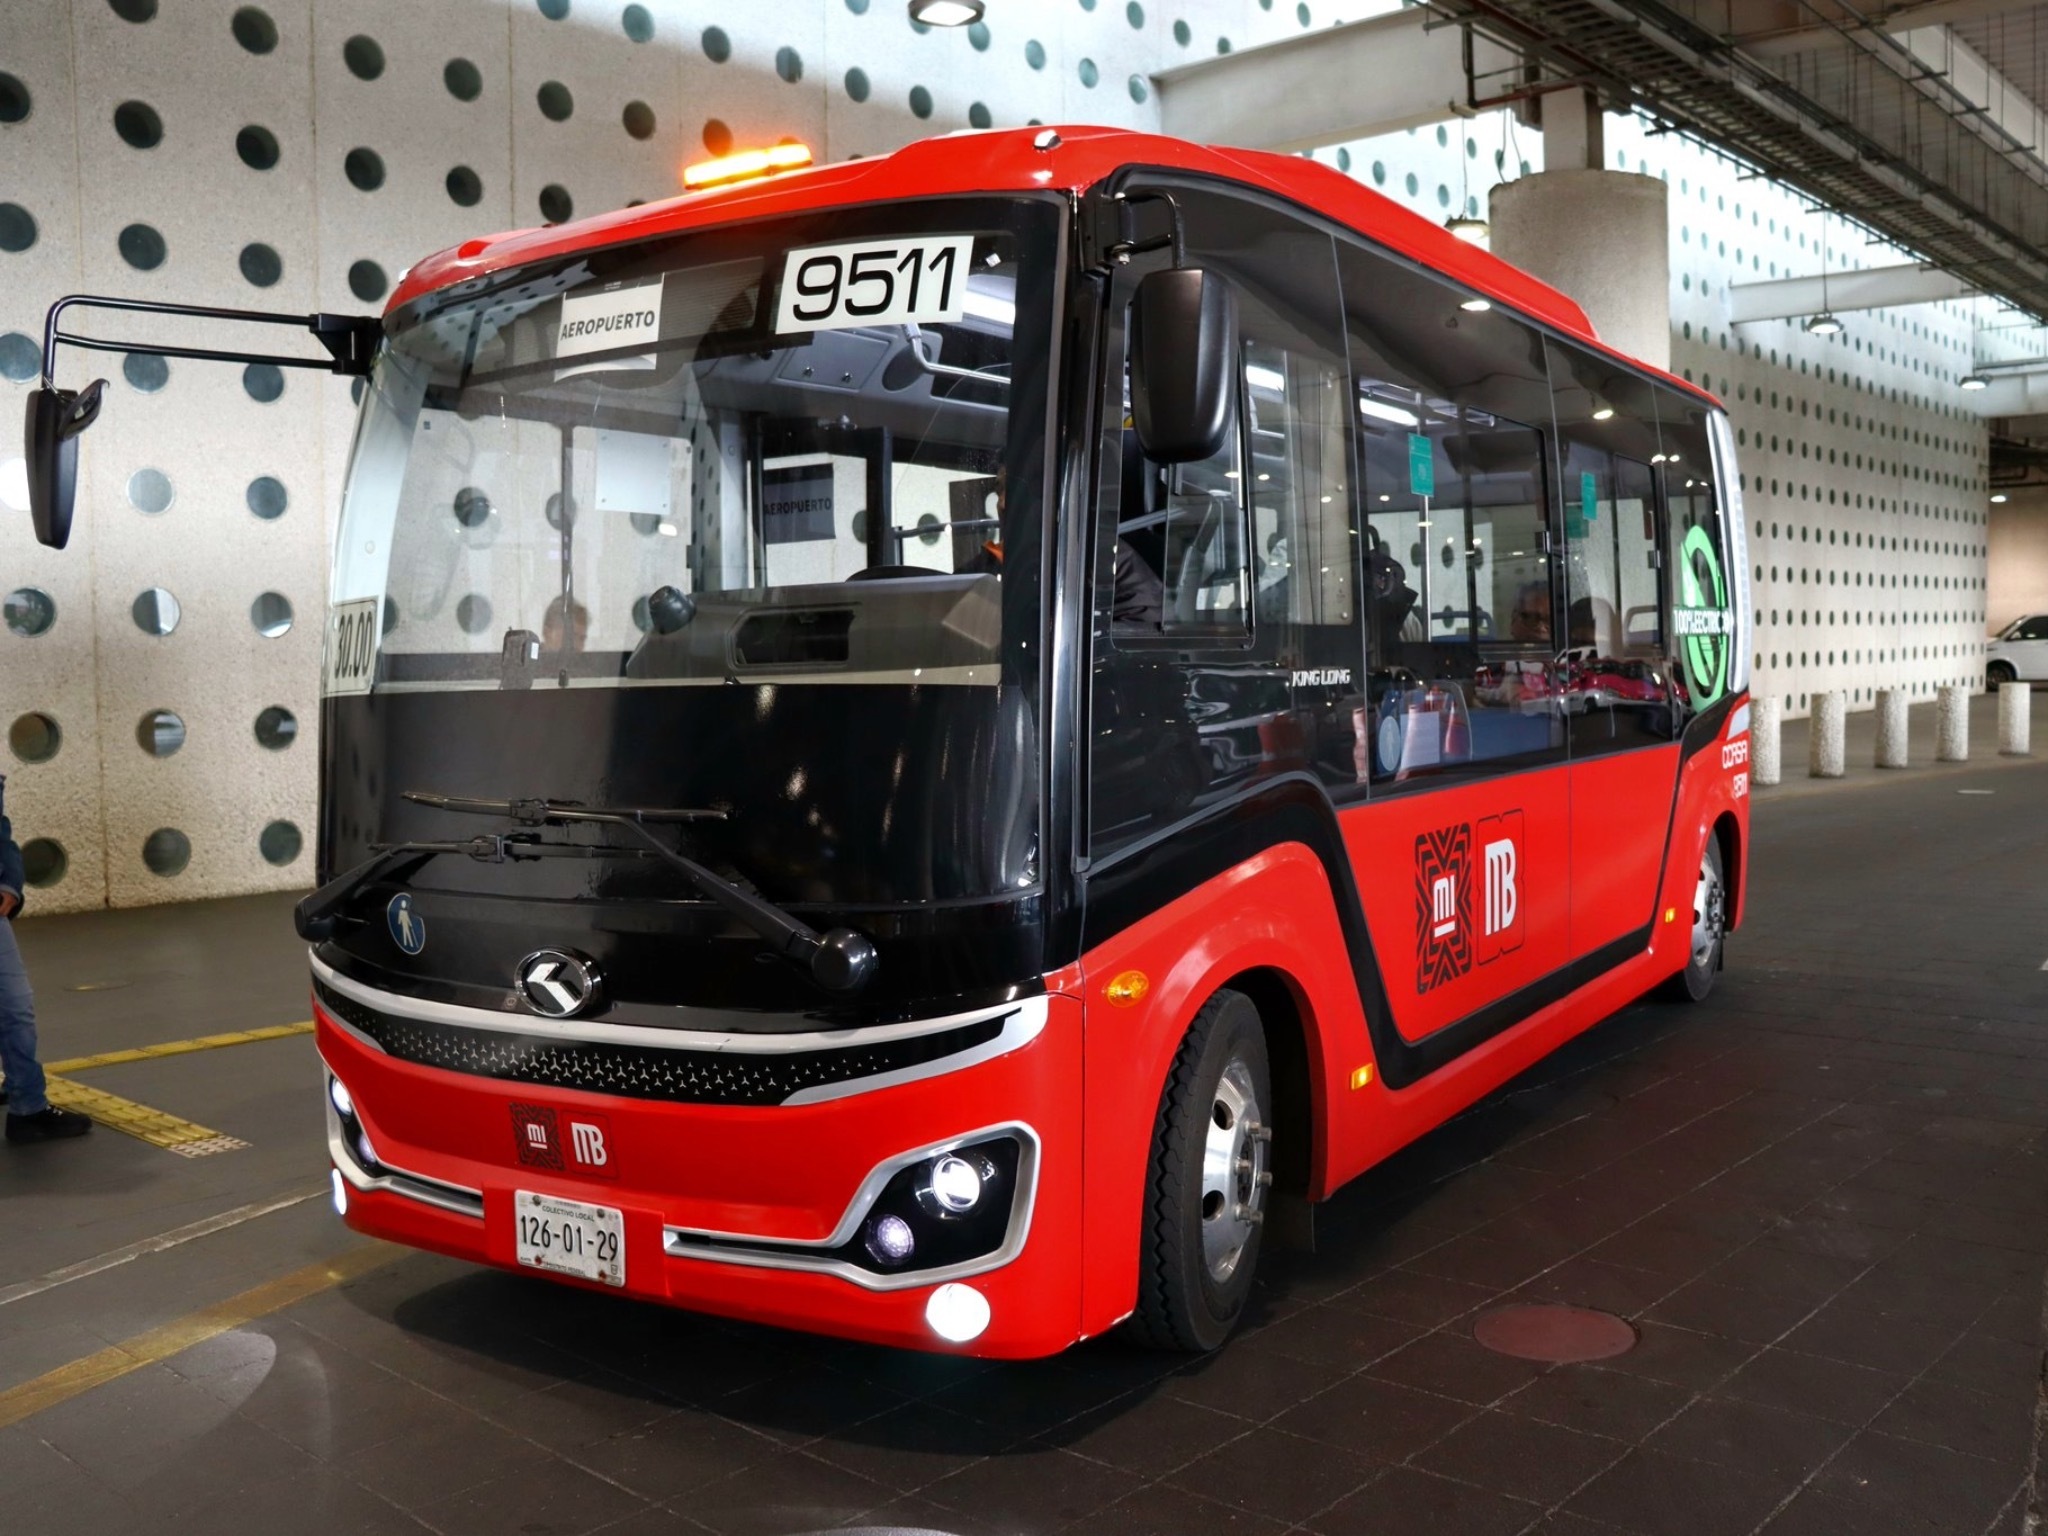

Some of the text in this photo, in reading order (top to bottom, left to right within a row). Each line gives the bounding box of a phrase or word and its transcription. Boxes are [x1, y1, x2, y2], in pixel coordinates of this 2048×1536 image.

[793, 247, 956, 321] 9511
[560, 310, 655, 340] AEROPUERTO
[764, 497, 831, 516] AEROPUERTO
[1292, 669, 1350, 687] KING LONG
[542, 1206, 595, 1222] COLECTIVO LOCAL
[521, 1215, 618, 1262] 126-01-29
